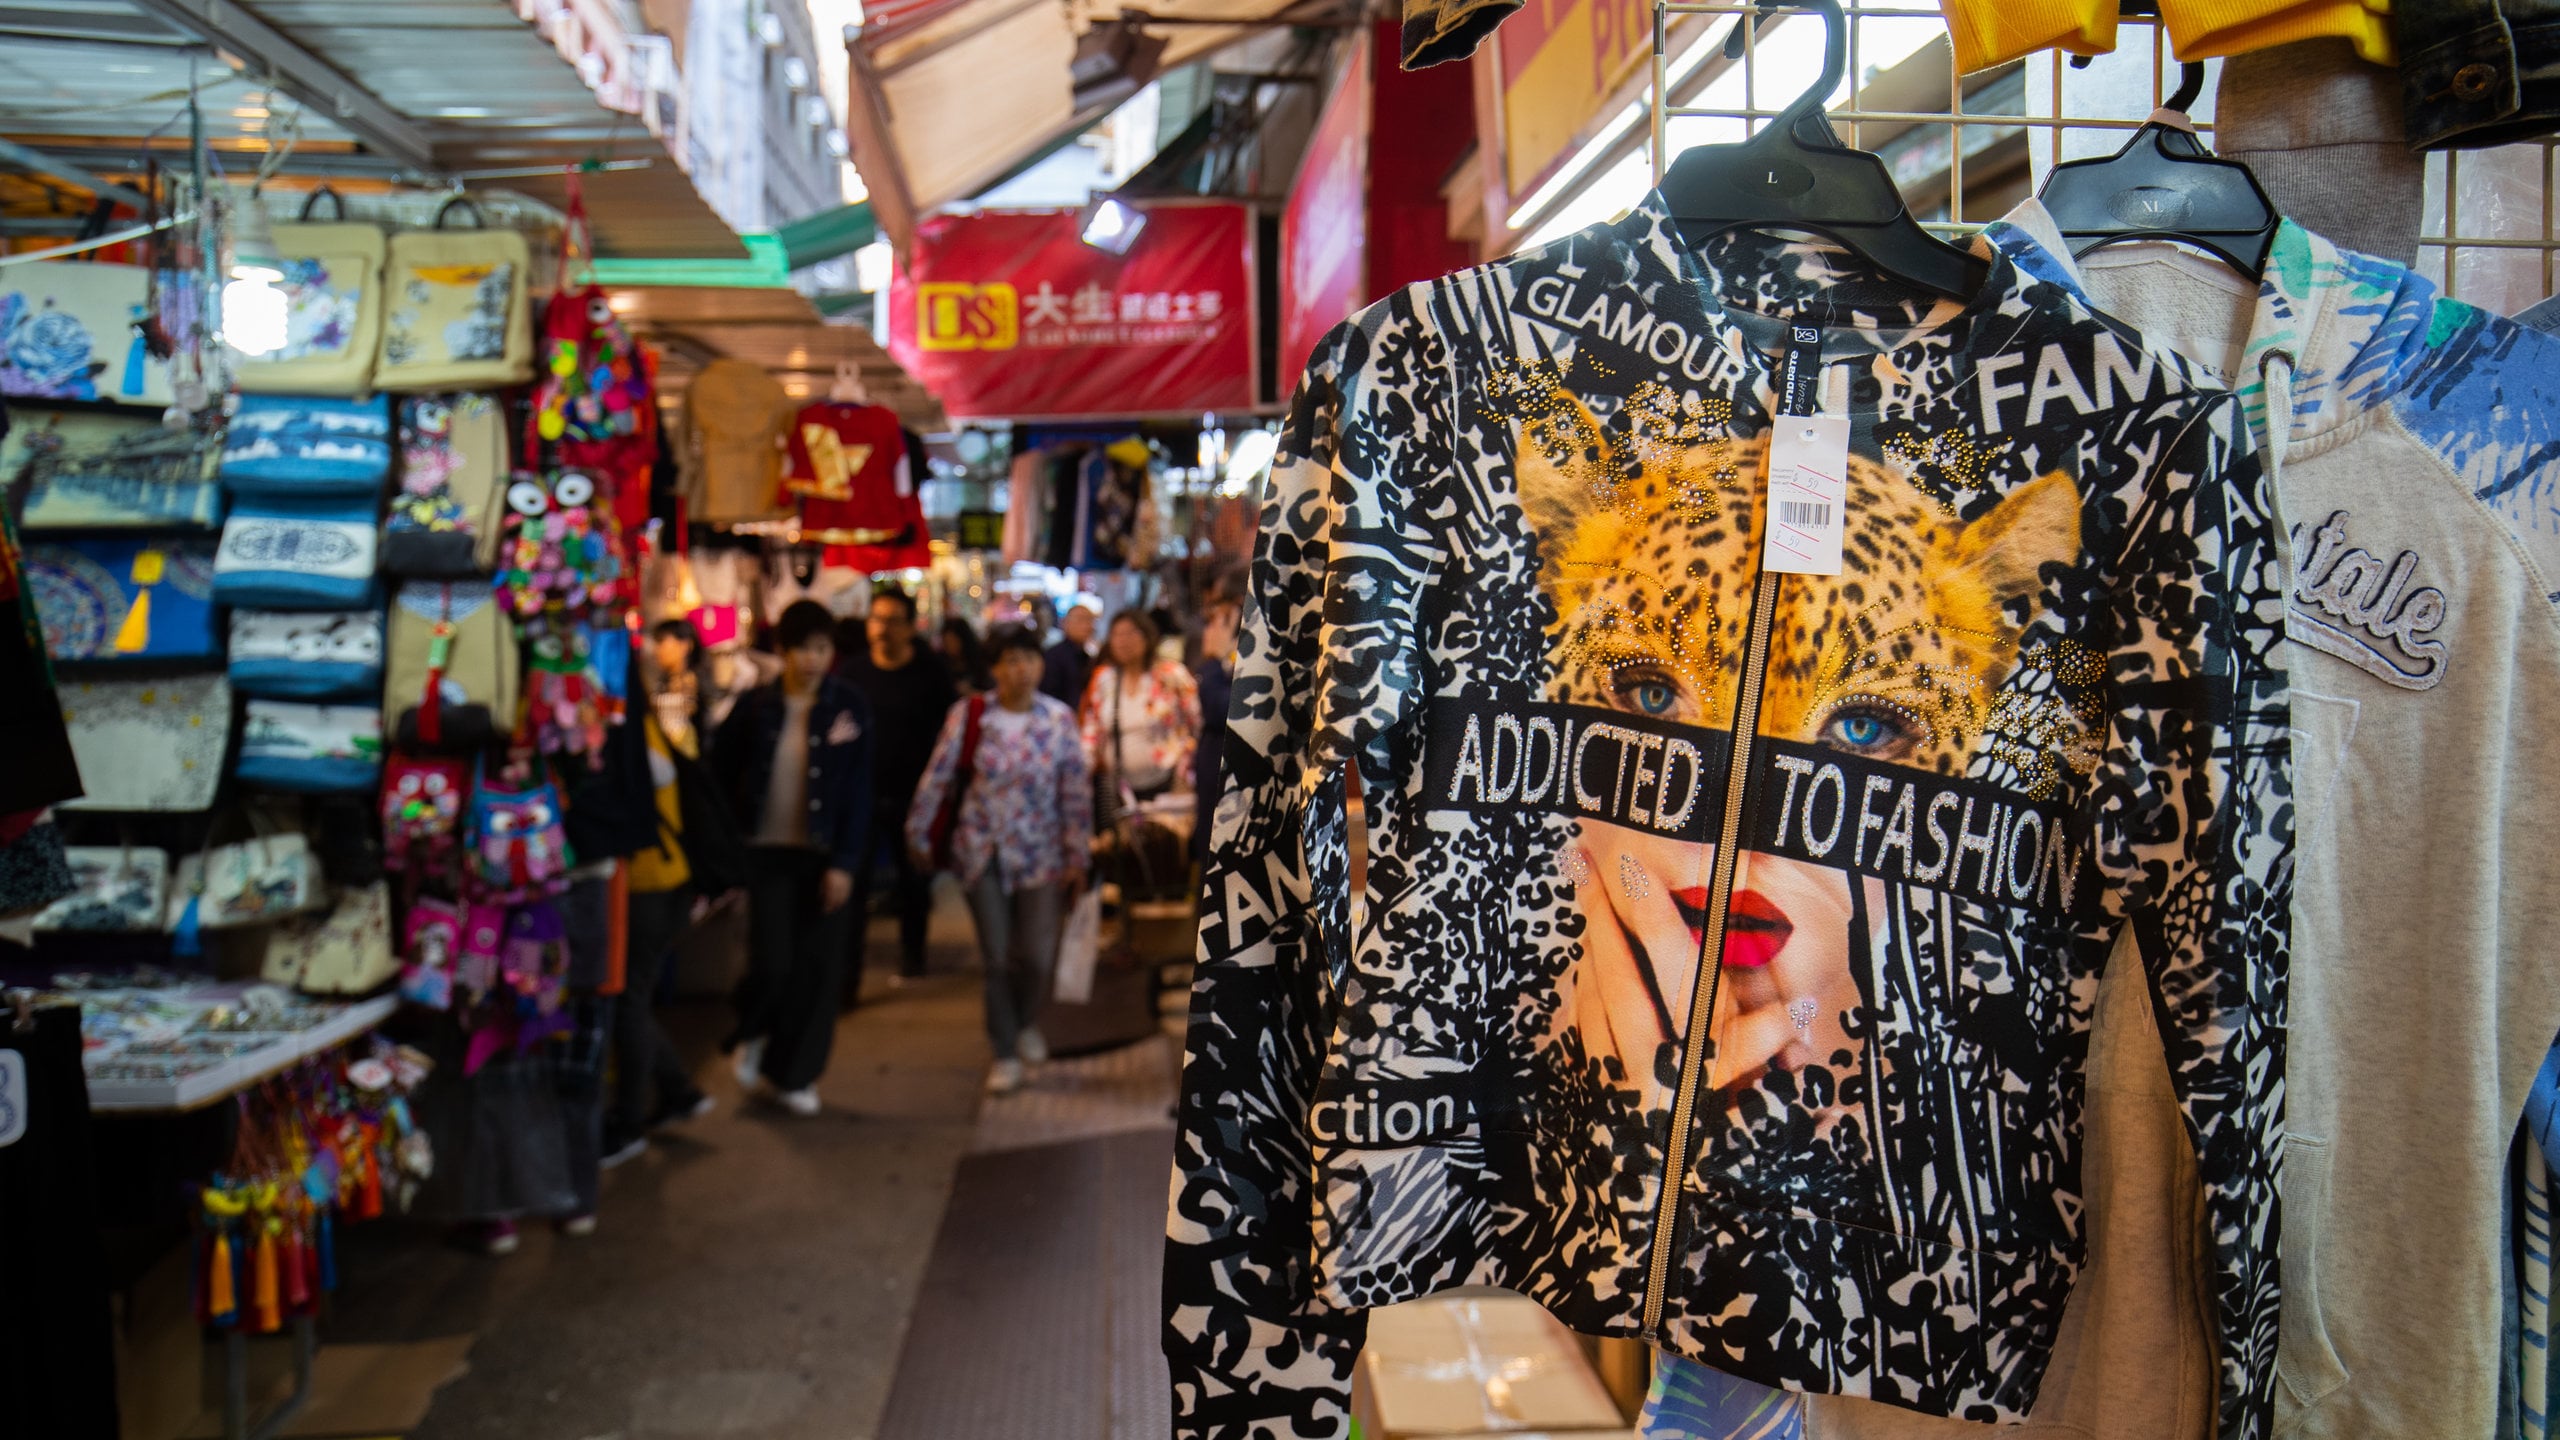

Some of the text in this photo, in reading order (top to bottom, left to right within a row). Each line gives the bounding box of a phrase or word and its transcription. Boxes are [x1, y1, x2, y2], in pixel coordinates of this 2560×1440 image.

[1766, 171, 1778, 185] L
[2141, 200, 2164, 214] XL
[1526, 276, 1746, 402] GLAMOUR
[1797, 330, 1816, 342] XS
[1447, 712, 2084, 914] ADDICTED TO FASHION
[1309, 1087, 1455, 1144] ction
